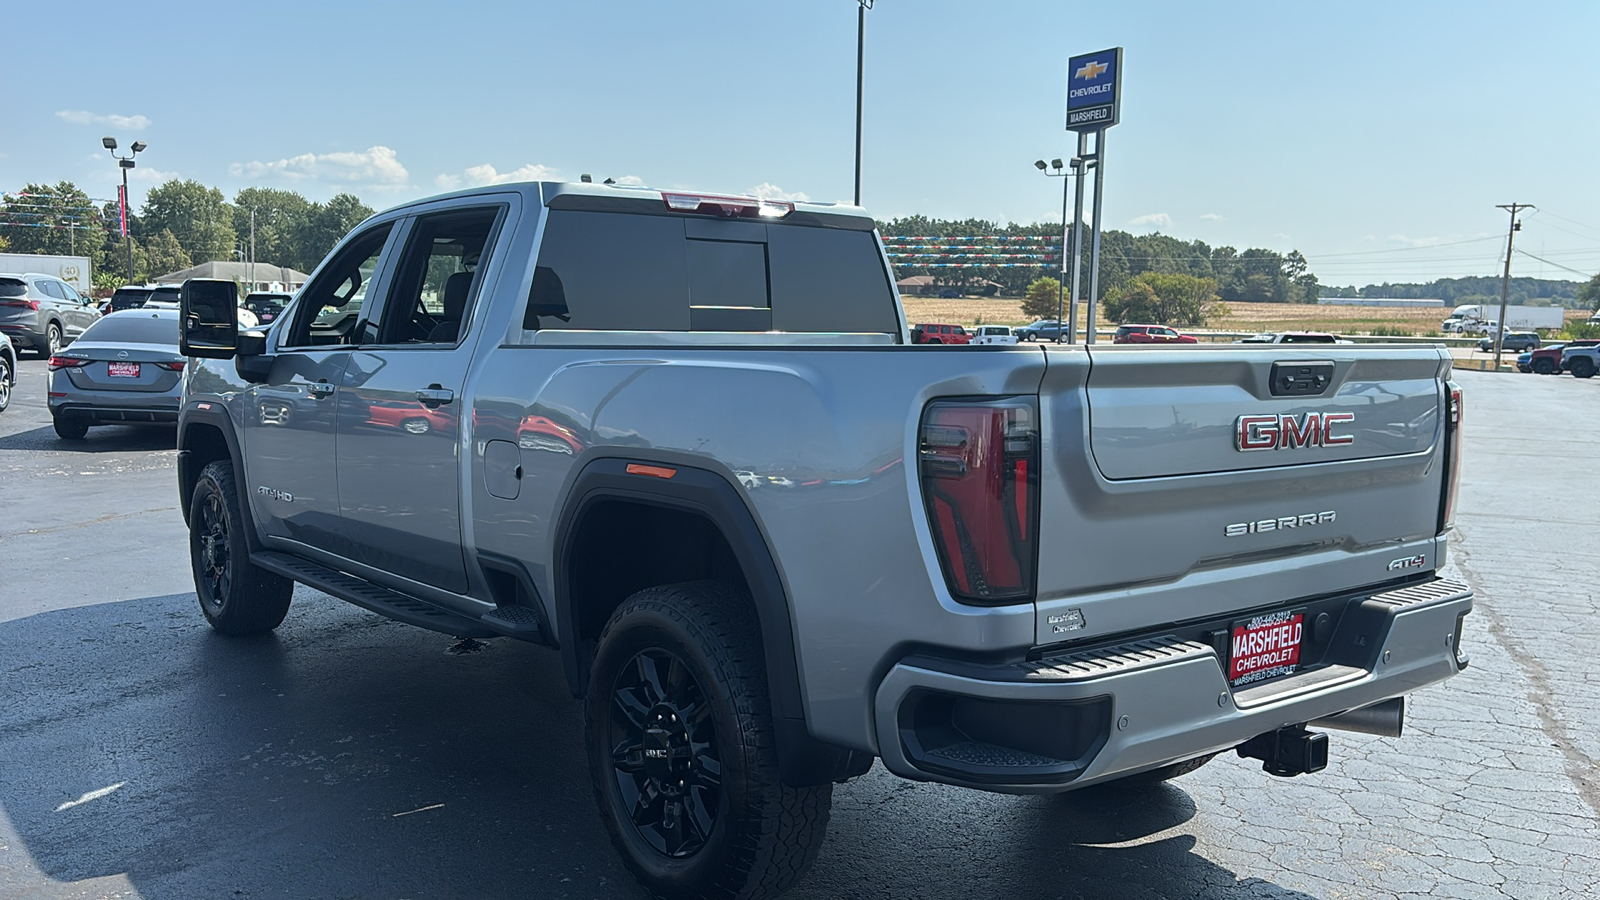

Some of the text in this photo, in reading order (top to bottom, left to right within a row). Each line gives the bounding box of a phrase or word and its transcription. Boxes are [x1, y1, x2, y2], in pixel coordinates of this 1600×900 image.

[1070, 83, 1112, 98] CHEVROLET
[1070, 108, 1108, 123] MARSHFIELD
[64, 266, 76, 275] 40
[1236, 412, 1355, 451] GMC
[1224, 510, 1336, 537] SIERRA
[1387, 554, 1425, 571] AT4
[1232, 623, 1302, 658] MARSHFIELD
[1236, 648, 1294, 672] CHEVROLET
[1234, 671, 1265, 687] MARSHFIELD
[1266, 664, 1297, 678] CHEVROLET
